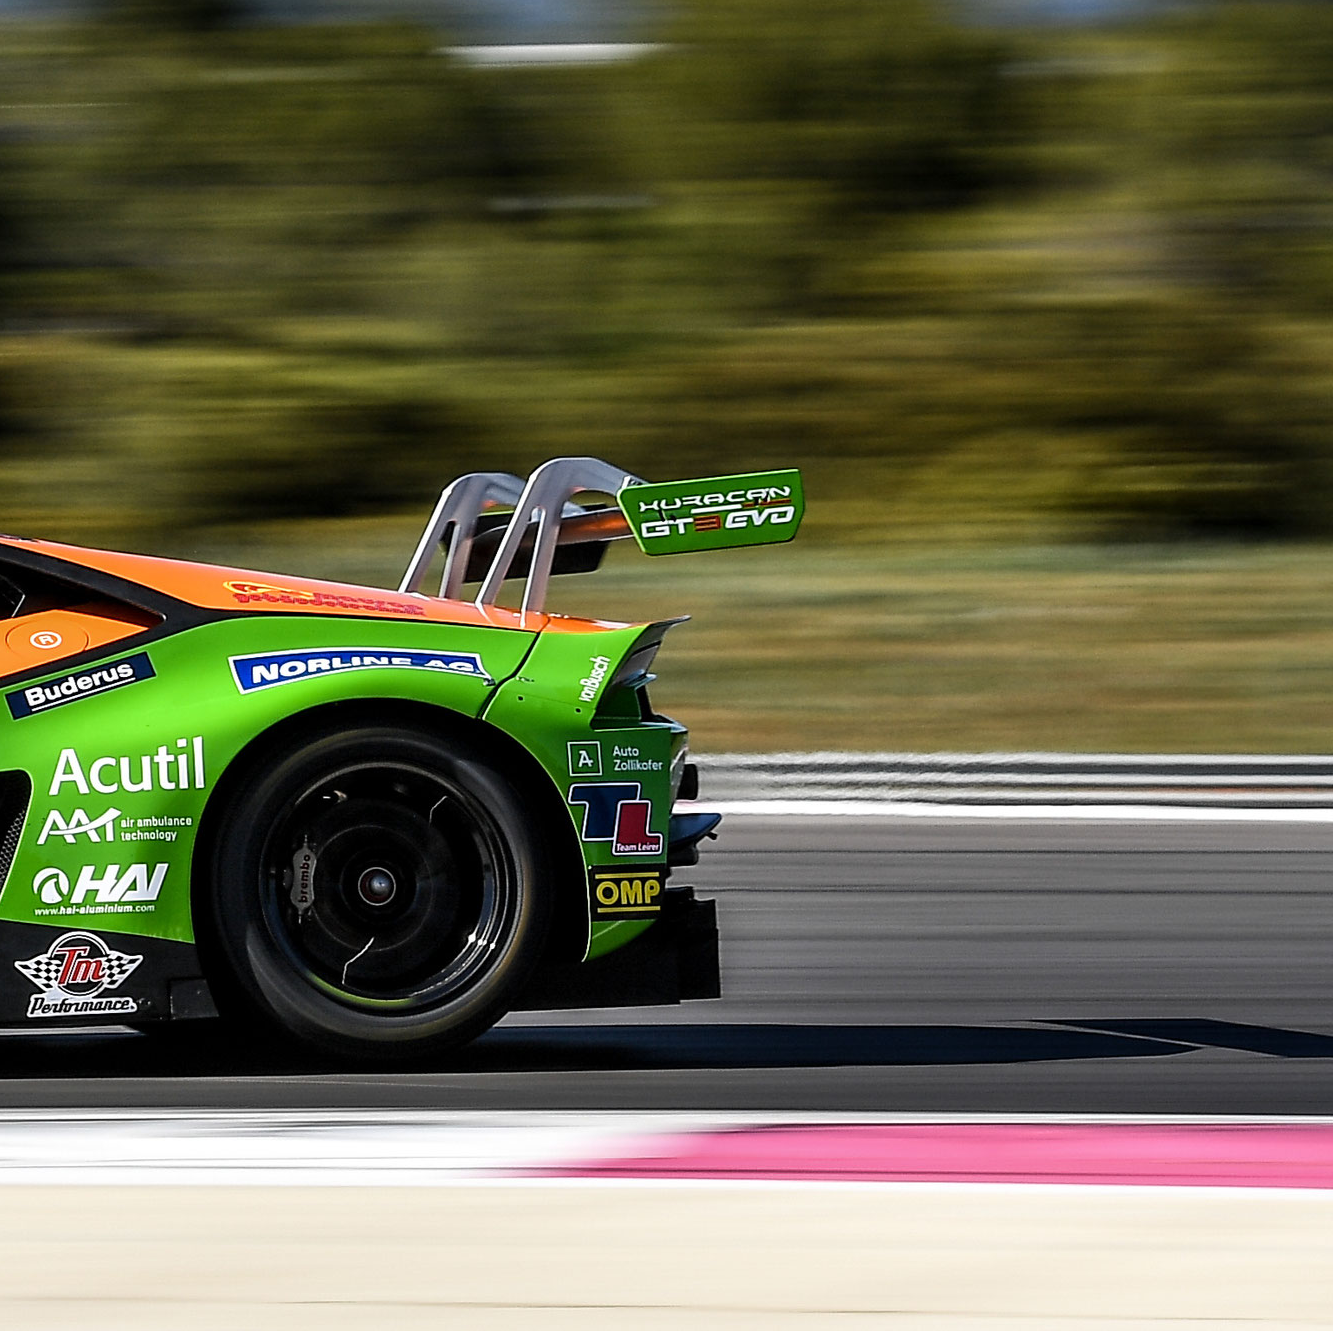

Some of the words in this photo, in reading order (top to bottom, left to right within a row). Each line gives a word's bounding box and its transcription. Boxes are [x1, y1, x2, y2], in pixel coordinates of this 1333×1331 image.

[725, 506, 795, 529] EVO
[251, 656, 413, 684] NORLINE
[24, 663, 134, 707] Buderus
[613, 745, 639, 757] Auto
[48, 736, 205, 796] Acutil
[614, 759, 663, 771] Zollikofer
[121, 817, 135, 828] air
[137, 816, 192, 828] ambulance
[121, 829, 177, 842] technology
[616, 843, 637, 852] Team
[298, 854, 311, 903] brembo
[596, 879, 661, 905] OMP
